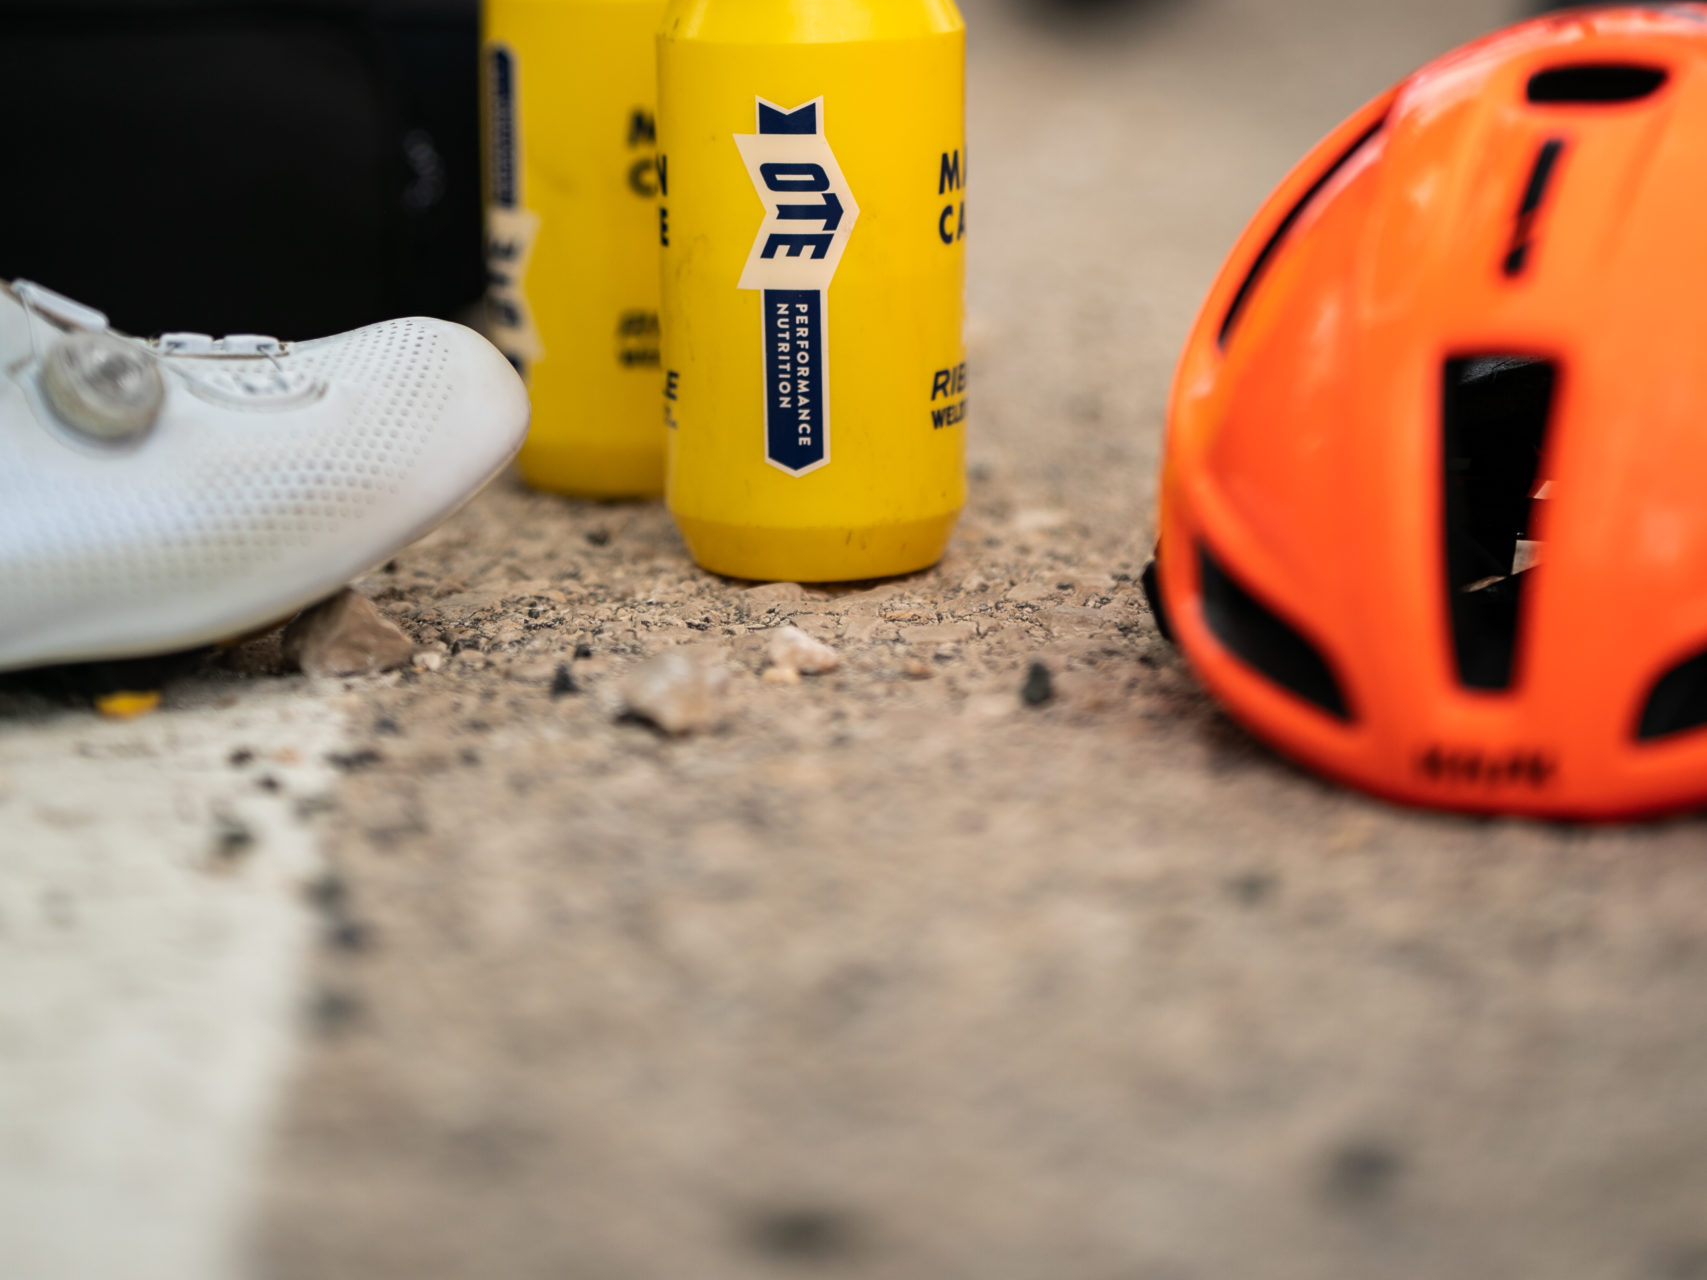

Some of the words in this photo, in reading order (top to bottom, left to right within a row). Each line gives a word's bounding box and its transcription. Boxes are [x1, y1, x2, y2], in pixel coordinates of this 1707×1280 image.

[759, 162, 844, 260] OTE
[939, 148, 967, 195] M
[776, 303, 792, 409] NUTRITION
[795, 303, 811, 447] PERFORMANCE
